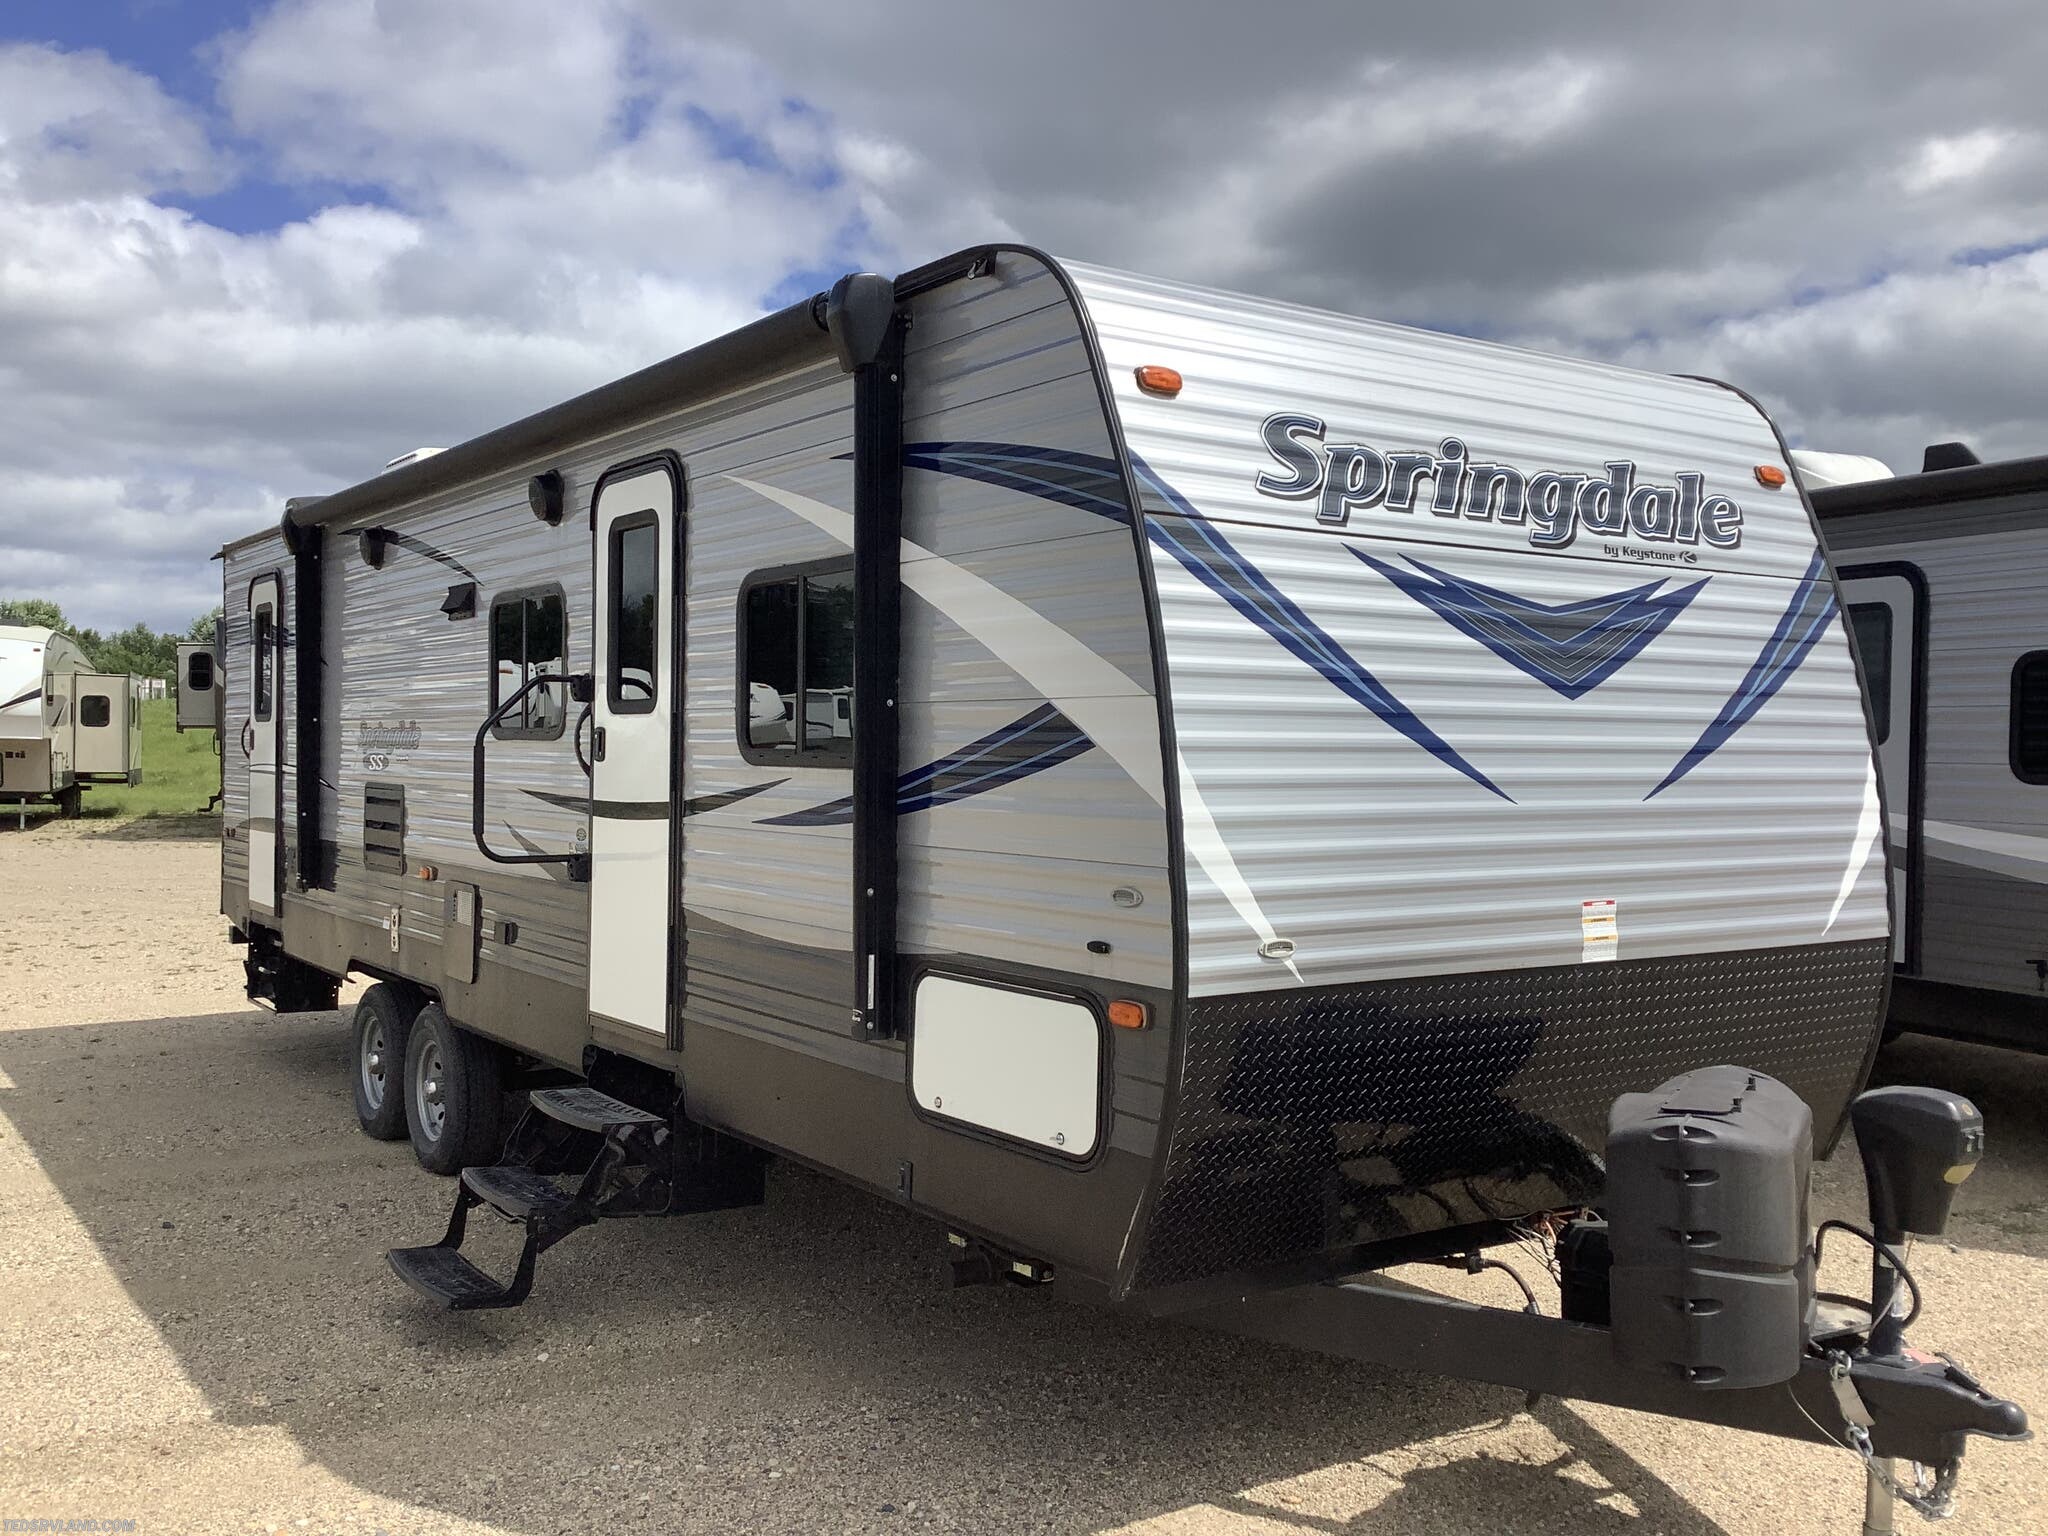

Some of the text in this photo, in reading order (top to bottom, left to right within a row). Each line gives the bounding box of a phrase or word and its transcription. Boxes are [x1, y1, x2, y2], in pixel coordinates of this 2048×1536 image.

[1255, 411, 1743, 547] Springdale
[1604, 544, 1676, 561] by Keystone
[368, 754, 384, 770] SS
